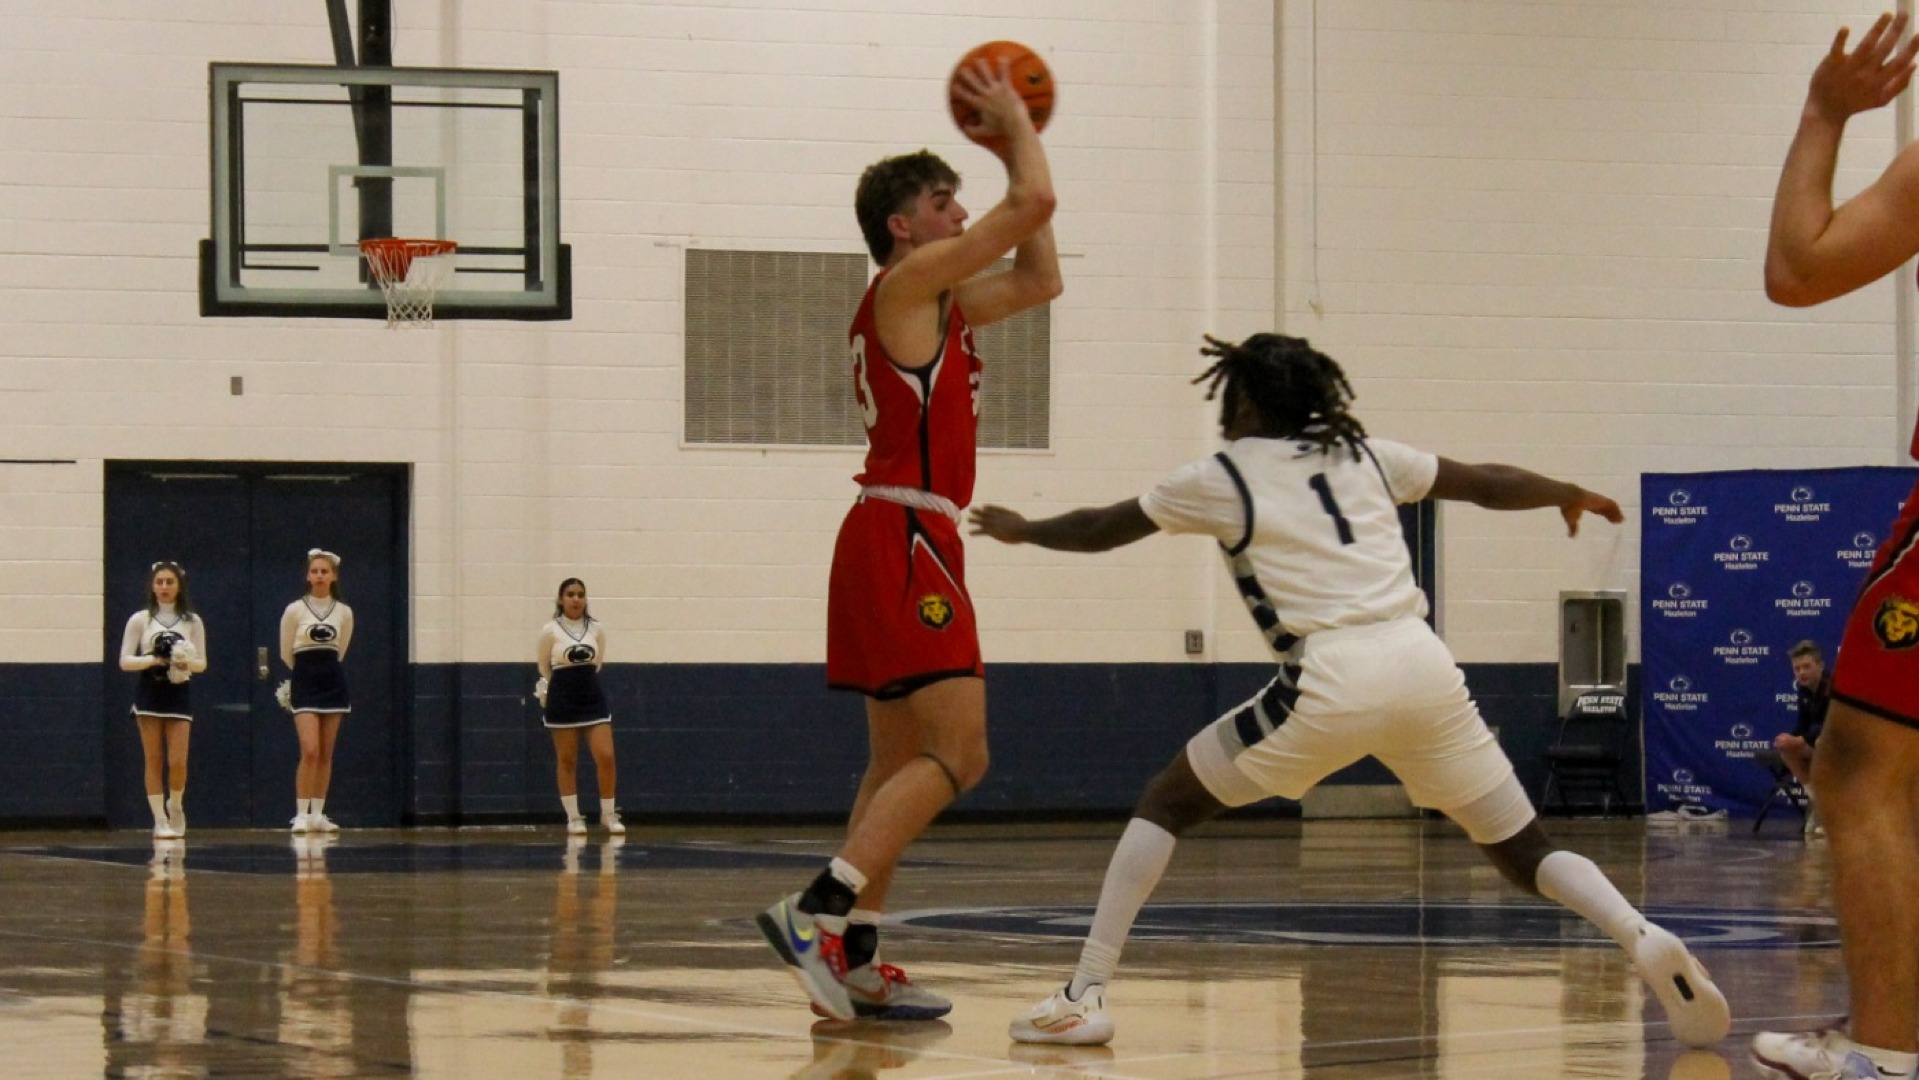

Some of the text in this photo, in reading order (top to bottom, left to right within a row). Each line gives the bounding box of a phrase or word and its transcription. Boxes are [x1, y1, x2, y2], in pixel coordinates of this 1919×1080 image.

[1309, 472, 1355, 545] 1
[1652, 506, 1708, 515] PENN STATE
[1774, 503, 1831, 513] PENN STATE
[1663, 516, 1696, 525] Hazleton
[1786, 513, 1819, 522] Hazleton
[1714, 552, 1769, 561] PENN STATE
[1837, 550, 1862, 559] PENN
[1725, 562, 1757, 570] Hazleton
[1652, 599, 1708, 609] PENN STATE
[1775, 598, 1831, 608] PENN STATE
[1663, 609, 1696, 618] Hazleton
[1786, 608, 1820, 616] Hazleton
[1713, 646, 1769, 655] PENN STATE
[1725, 656, 1758, 665] Hazleton
[1653, 693, 1709, 702] PENN STATE
[1664, 703, 1697, 711] Hazleton
[1715, 740, 1770, 749] PENN STATE
